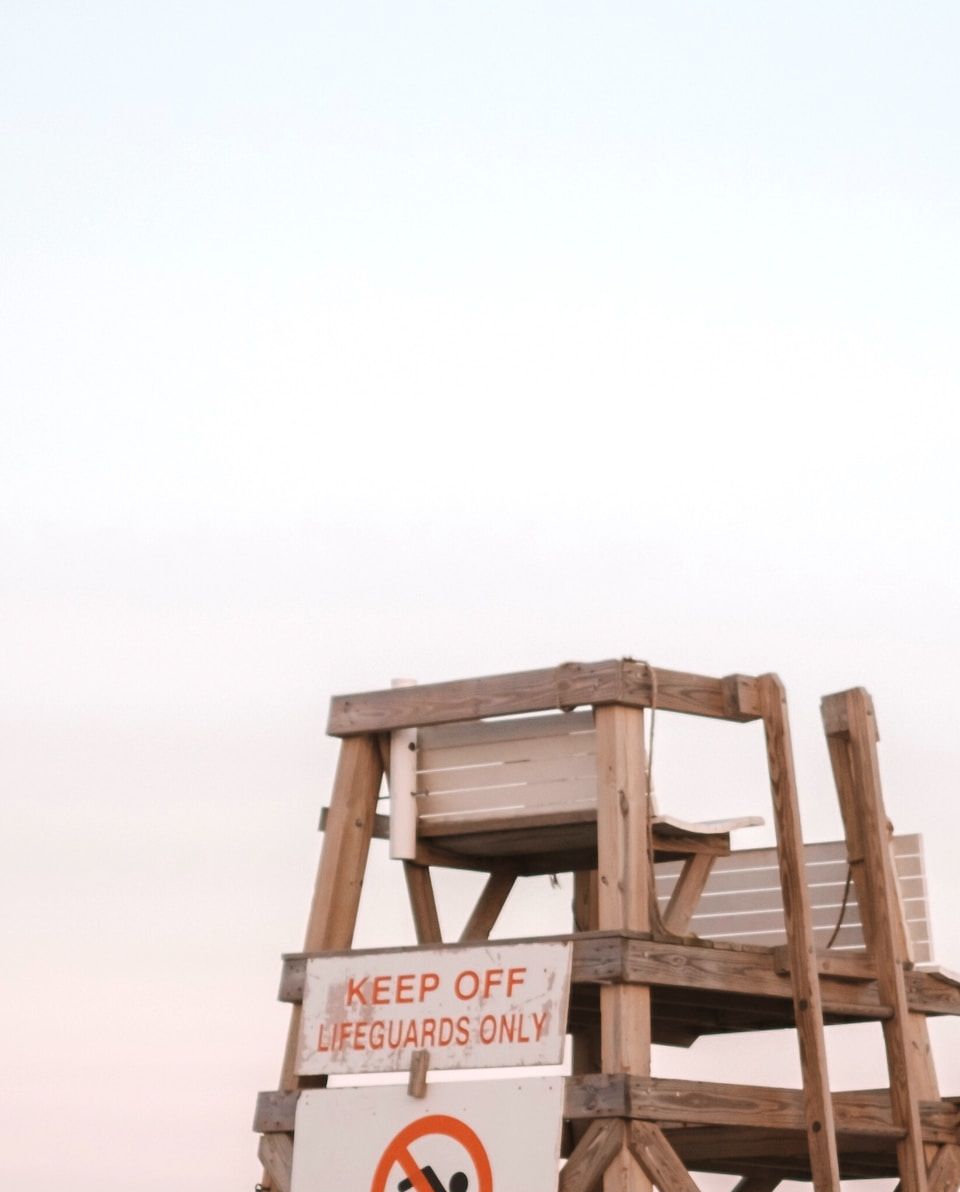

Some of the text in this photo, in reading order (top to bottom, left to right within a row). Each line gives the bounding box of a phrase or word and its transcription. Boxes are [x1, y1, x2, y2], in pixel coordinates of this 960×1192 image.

[346, 967, 527, 1006] KEEP OFF
[318, 1012, 547, 1052] LIFEGUARDS ONLY
